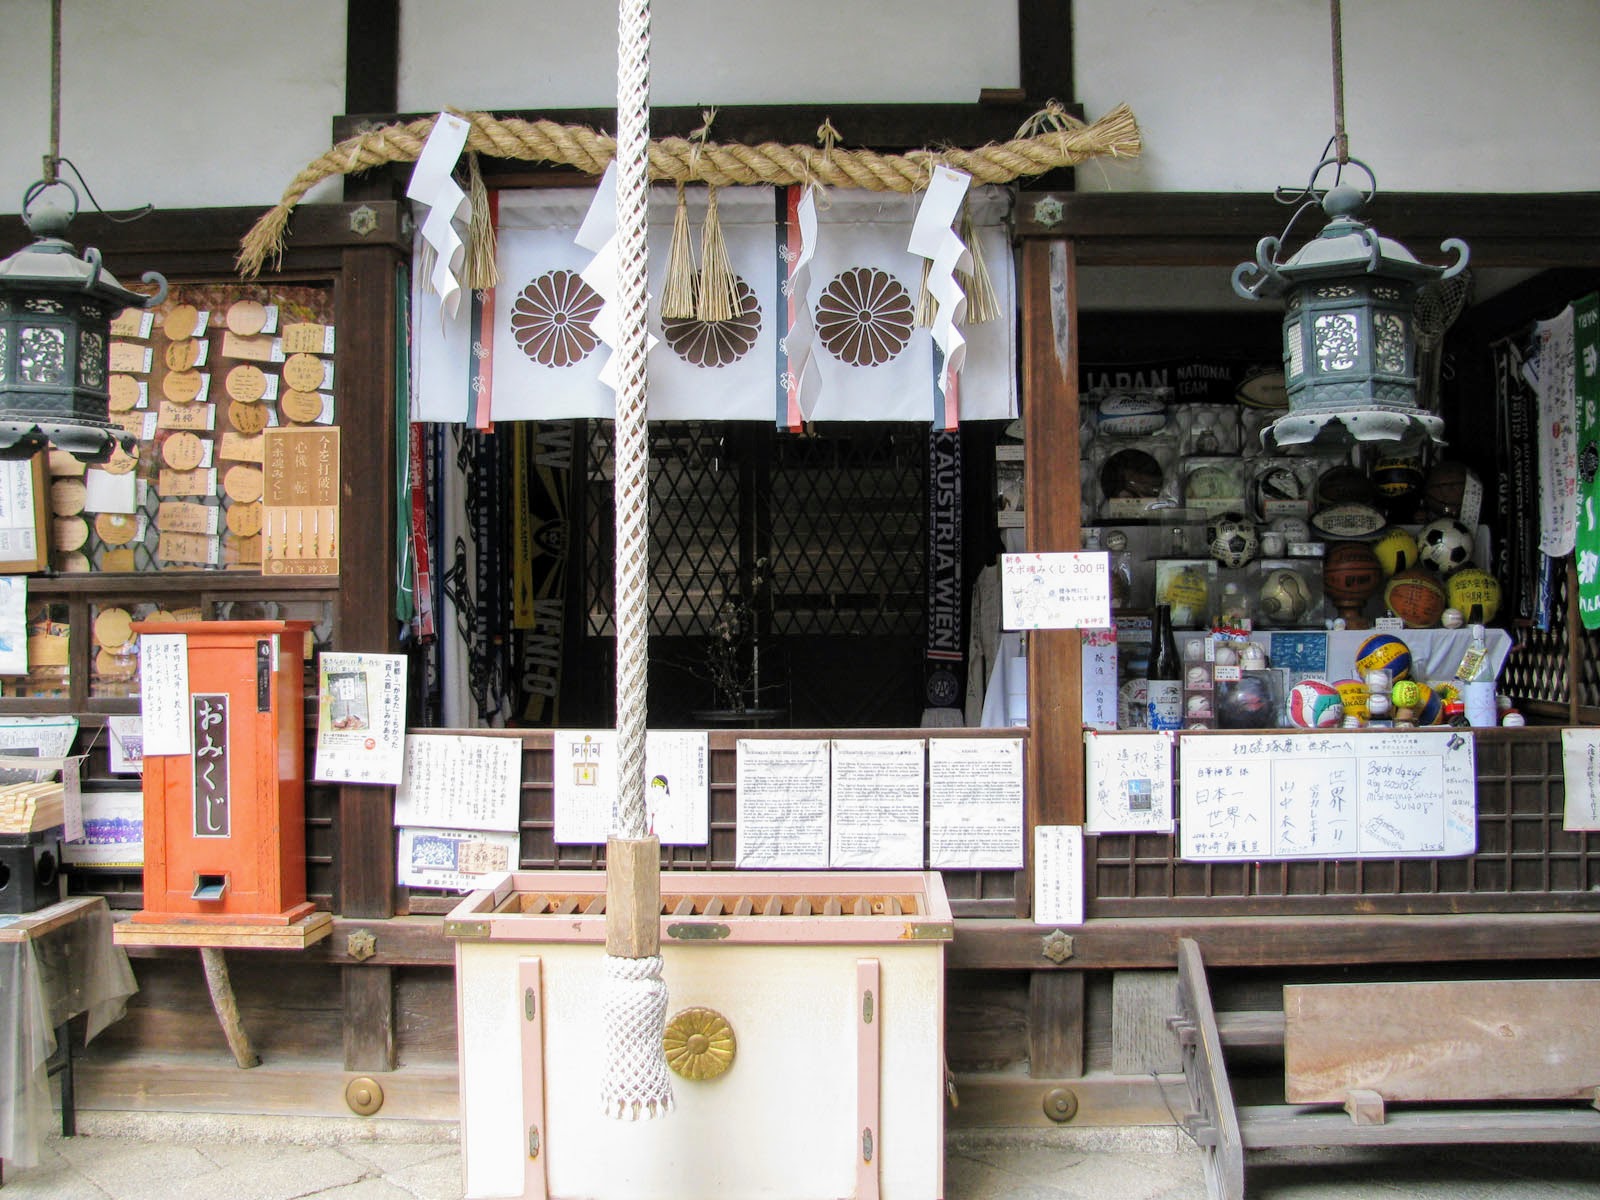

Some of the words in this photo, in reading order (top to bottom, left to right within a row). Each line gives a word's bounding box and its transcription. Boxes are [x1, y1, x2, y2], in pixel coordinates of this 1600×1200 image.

[936, 451, 955, 570] AUSTRIA
[936, 574, 954, 648] WIEN
[198, 700, 225, 833] おみくじ
